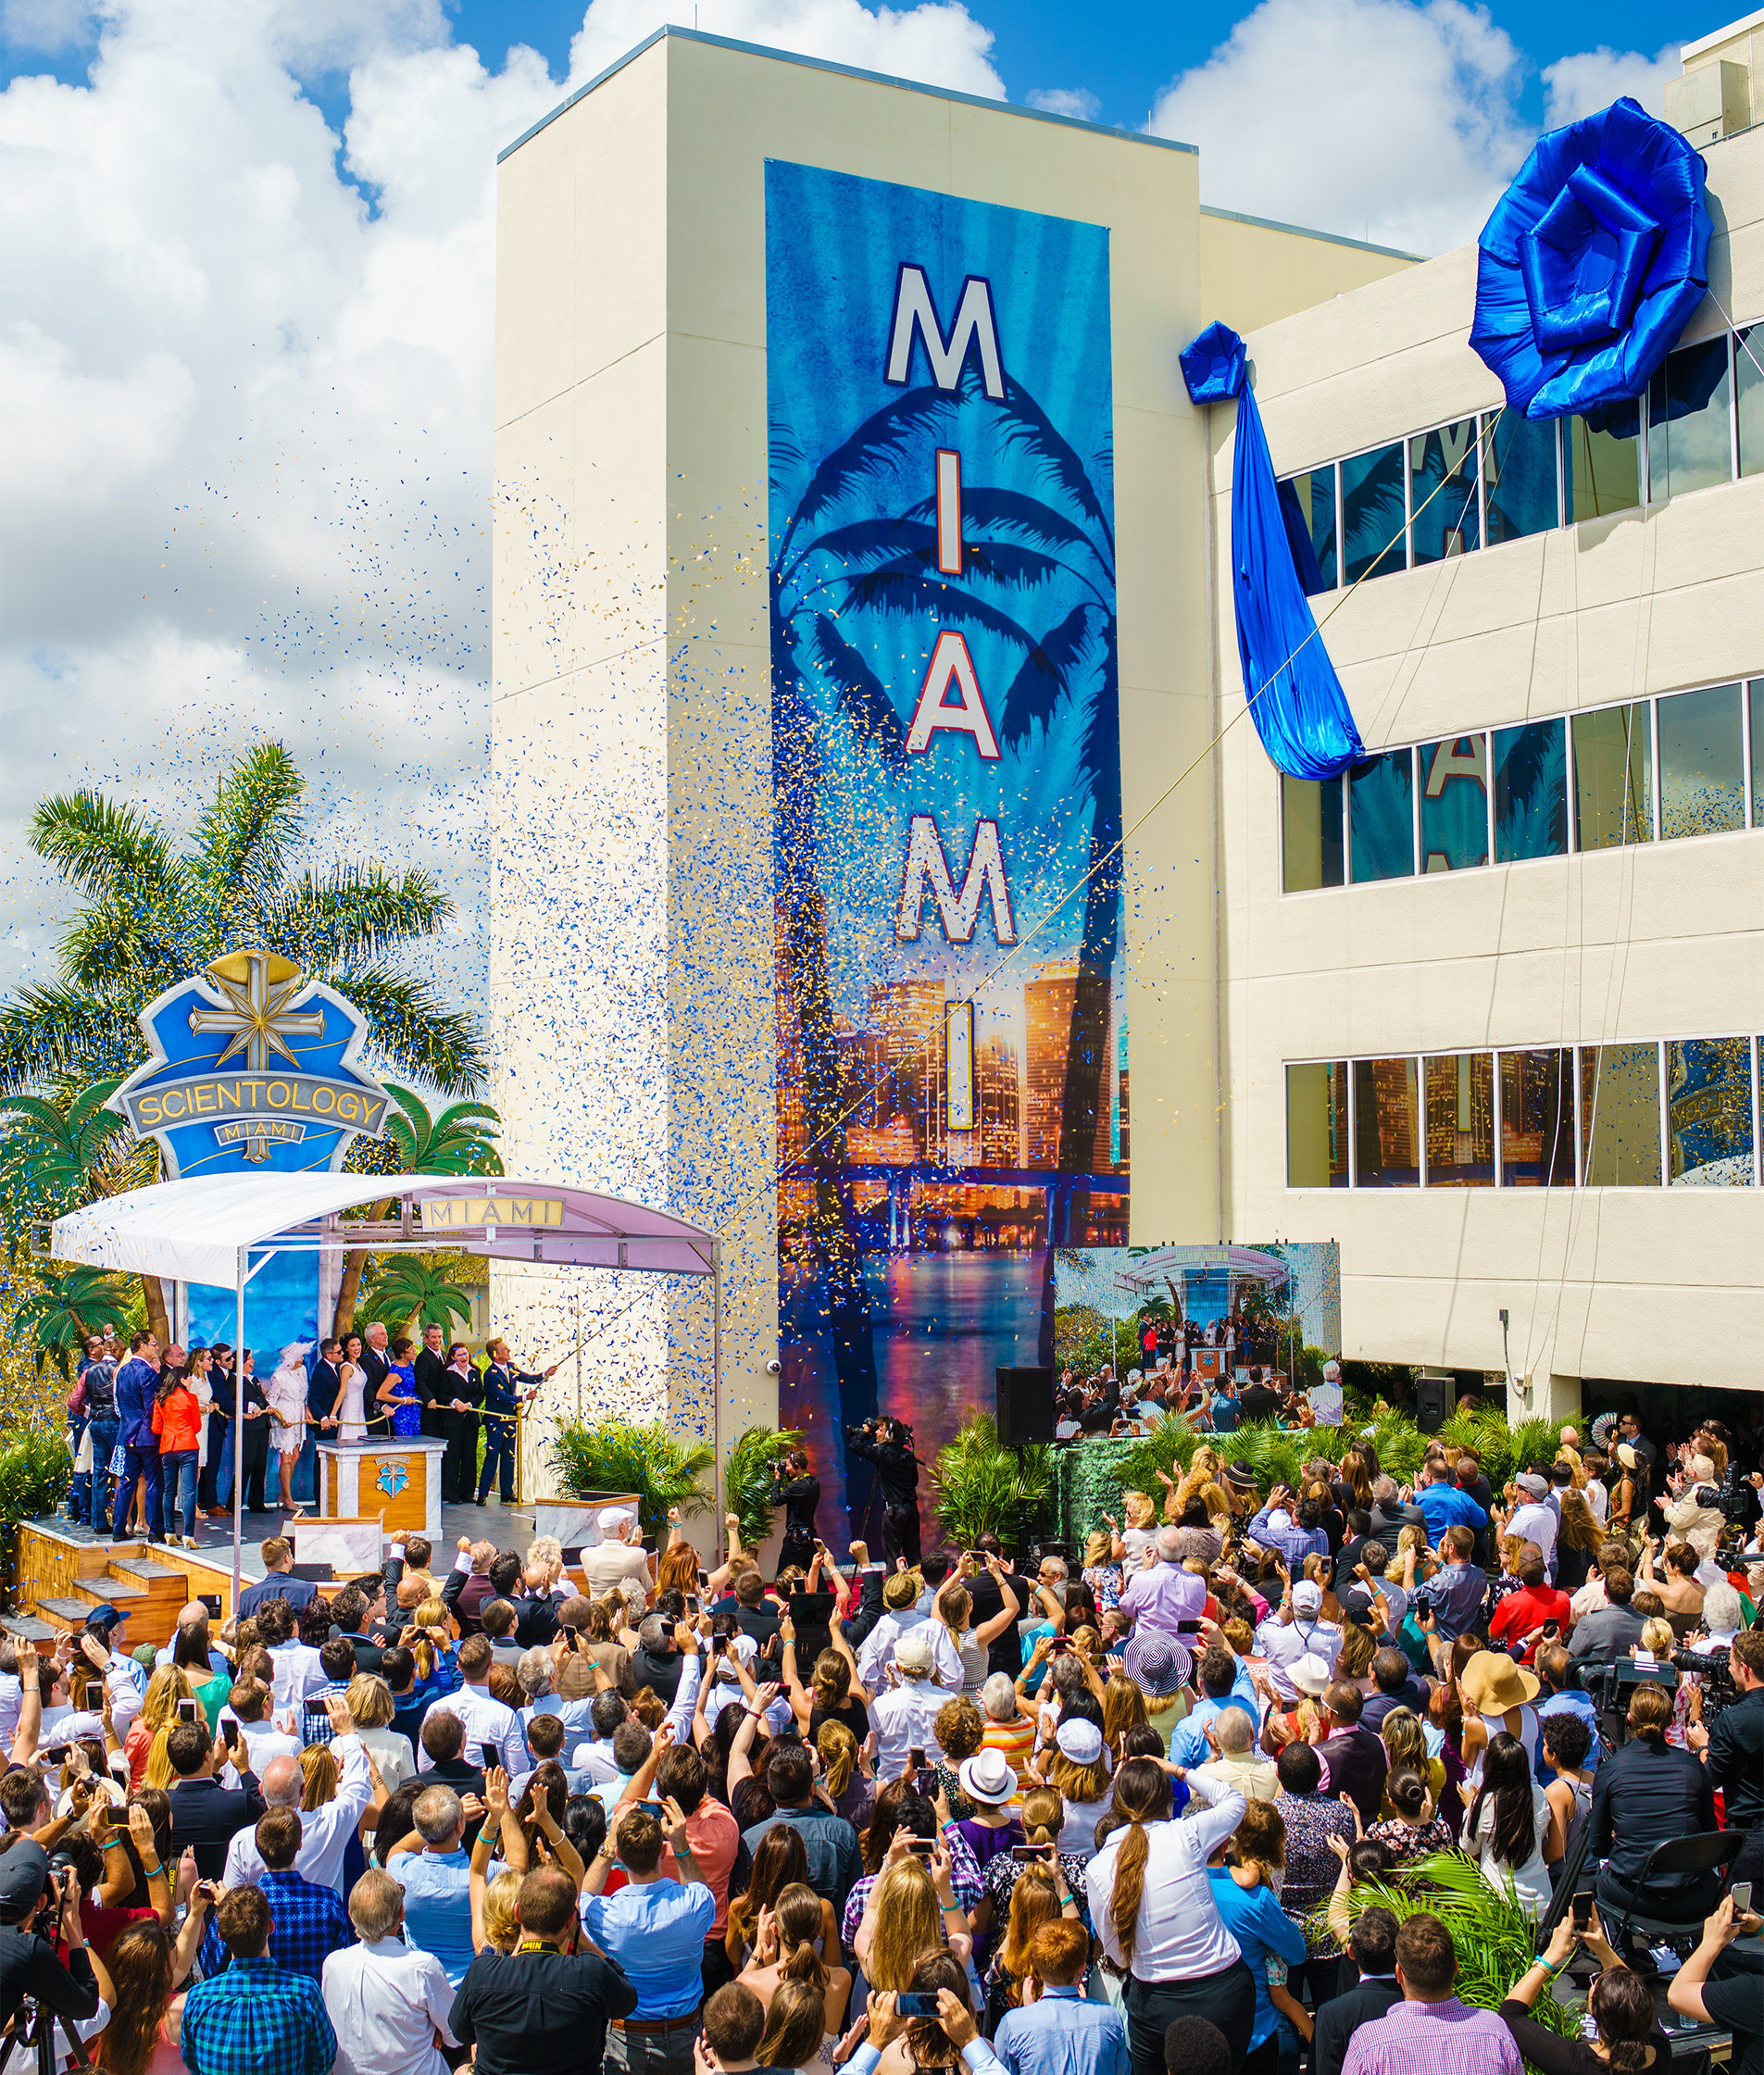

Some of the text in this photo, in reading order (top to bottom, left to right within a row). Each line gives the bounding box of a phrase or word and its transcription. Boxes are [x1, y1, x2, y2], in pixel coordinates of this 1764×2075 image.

[884, 262, 1018, 1131] MIAMI
[137, 1081, 382, 1125] SCIENTOLOGY
[223, 1121, 296, 1141] MIAMI
[431, 1200, 550, 1225] MIAMI
